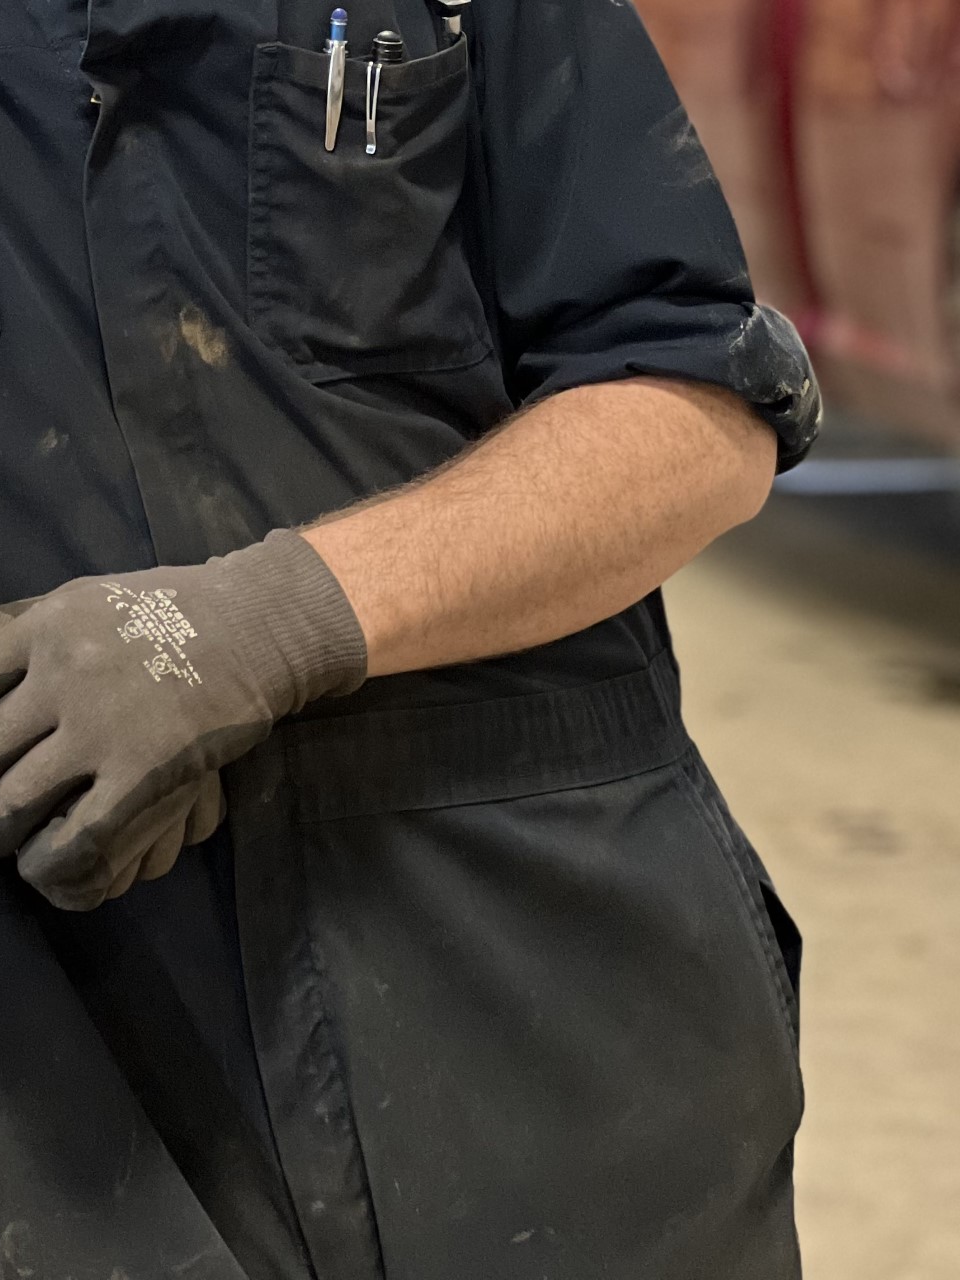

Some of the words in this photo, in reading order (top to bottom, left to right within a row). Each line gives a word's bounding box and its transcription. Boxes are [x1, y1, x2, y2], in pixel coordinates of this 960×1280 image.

[140, 590, 186, 645] VAPOR
[155, 590, 198, 638] WATSON
[181, 669, 193, 687] XL
